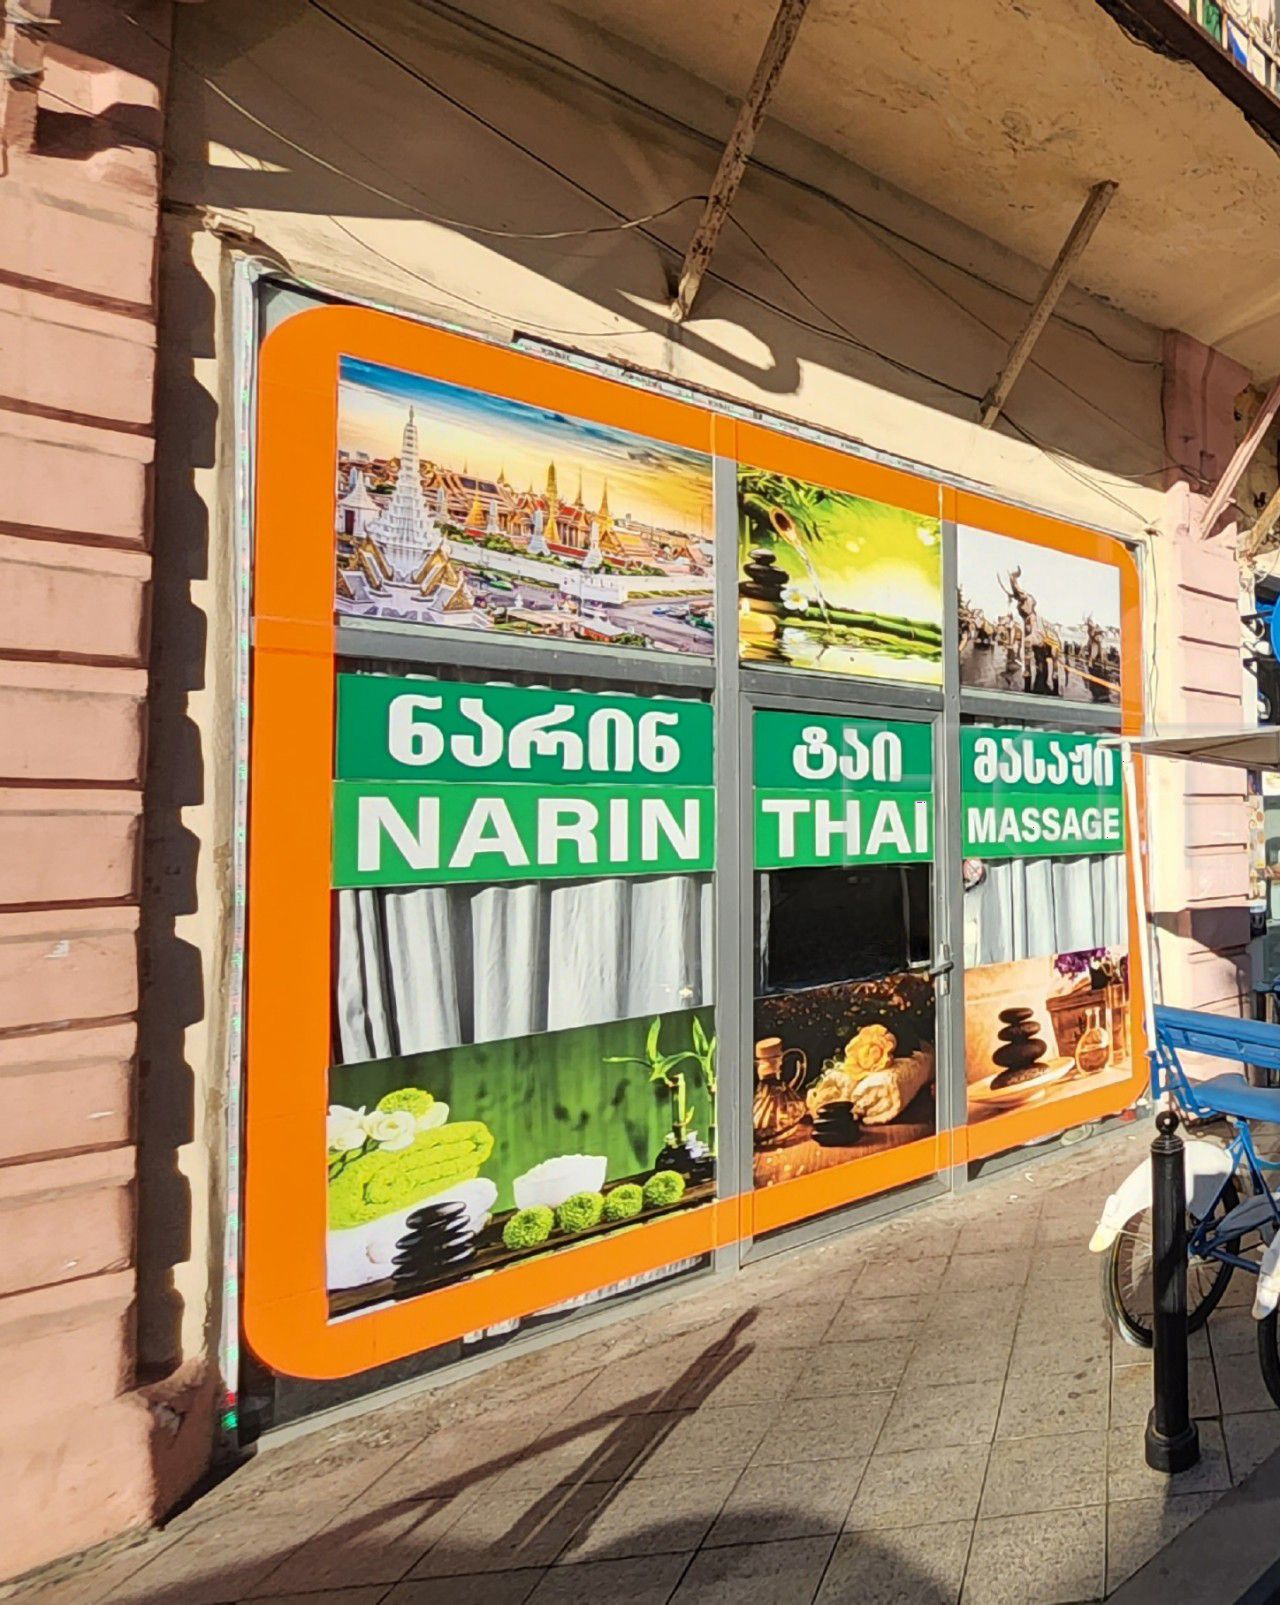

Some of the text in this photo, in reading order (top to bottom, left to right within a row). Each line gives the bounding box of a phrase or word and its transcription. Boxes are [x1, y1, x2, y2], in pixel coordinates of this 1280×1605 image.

[388, 694, 1114, 786] ნარინ ტაი მასაჟი
[357, 796, 1120, 872] NARIN THAI MASSAGE
